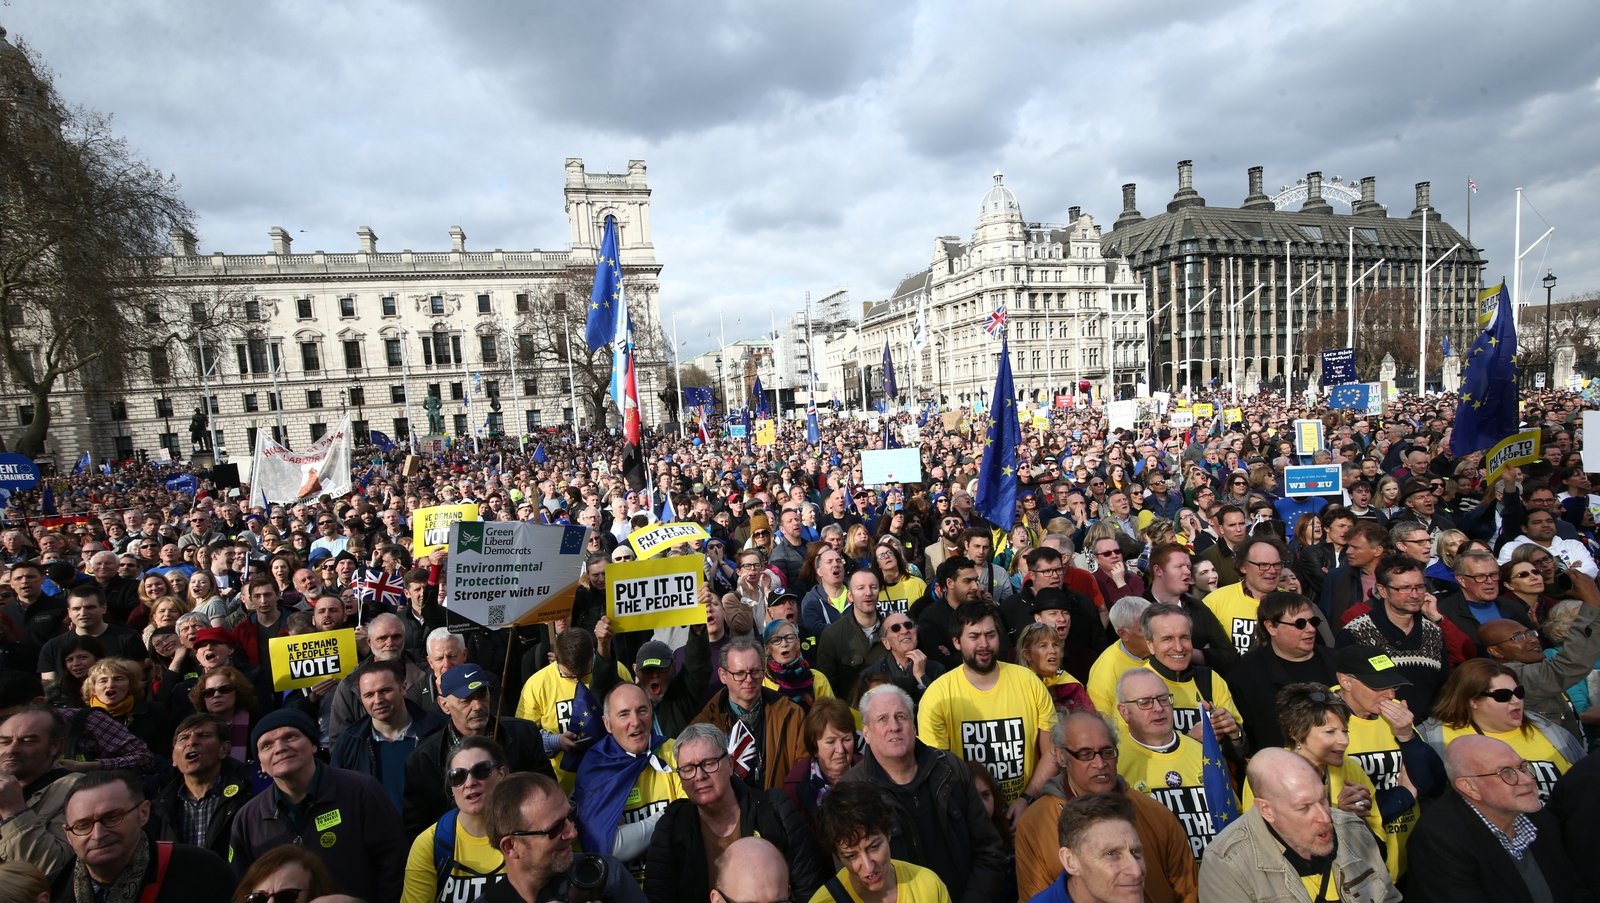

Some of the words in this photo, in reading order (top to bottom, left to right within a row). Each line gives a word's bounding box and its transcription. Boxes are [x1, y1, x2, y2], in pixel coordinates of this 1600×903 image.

[1490, 450, 1502, 468] PUT
[1504, 444, 1514, 454] IT
[1518, 440, 1532, 450] TO
[1490, 460, 1500, 474] THE
[1500, 448, 1532, 464] PEOPLE
[434, 511, 463, 520] DEMAND
[425, 528, 450, 546] VOT
[486, 527, 514, 537] Green
[638, 530, 660, 545] PUT
[664, 526, 676, 534] IT
[640, 540, 660, 550] THE
[661, 530, 696, 541] PEOPLE
[484, 537, 514, 546] Liberal
[484, 546, 532, 555] Democrats
[456, 562, 544, 574] Environmental
[455, 575, 519, 588] Protection
[616, 580, 648, 600] PUT
[654, 578, 668, 596] IT
[674, 576, 694, 593] TO
[454, 588, 507, 602] Stronger
[510, 587, 534, 598] with
[536, 586, 550, 596] EU
[616, 600, 642, 614] THE
[646, 592, 694, 610] PEOPLE
[896, 600, 908, 610] IT
[1233, 618, 1257, 635] PU
[287, 643, 299, 652] WE
[302, 638, 338, 650] DEMAND
[1232, 634, 1250, 648] TO
[288, 652, 294, 660] A
[296, 646, 338, 660] PEOPLE'S
[290, 655, 340, 678] VOTE
[1173, 710, 1195, 730] UT
[962, 722, 998, 744] PUT
[1004, 719, 1022, 741] IT
[964, 744, 986, 762] TO
[990, 740, 1024, 762] THE
[982, 758, 1024, 780] OPLE
[1531, 762, 1558, 782] IT
[1388, 824, 1408, 834] 2019
[441, 876, 486, 903] PUT
